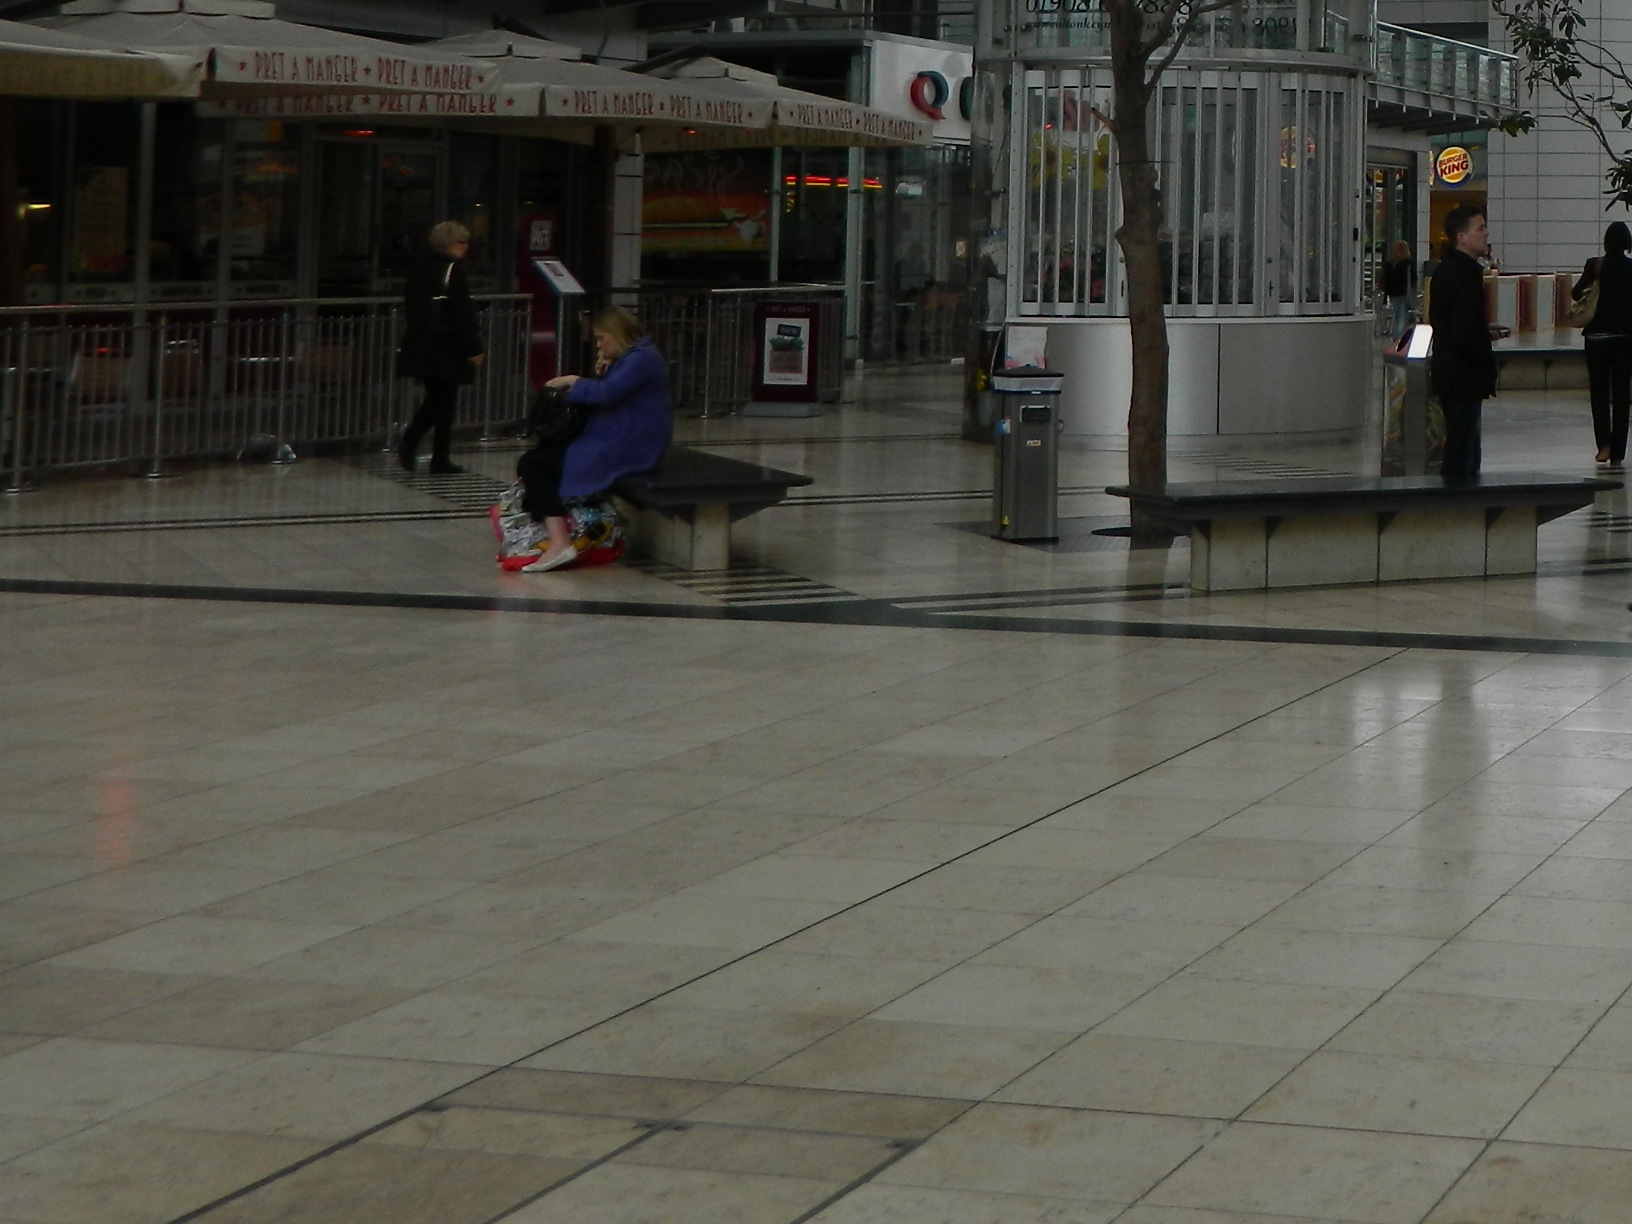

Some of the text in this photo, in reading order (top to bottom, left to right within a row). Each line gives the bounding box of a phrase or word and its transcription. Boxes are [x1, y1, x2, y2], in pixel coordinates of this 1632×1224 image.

[255, 50, 285, 79] PRET
[306, 54, 358, 83] MANGER
[377, 56, 407, 86] PRET
[425, 64, 473, 90] MANGER
[574, 90, 597, 114] PRET
[613, 91, 654, 115] MANGER
[670, 94, 691, 118] PRET
[706, 99, 743, 123] MANGER
[1439, 153, 1468, 168] BURGER
[1440, 160, 1469, 178] KING
